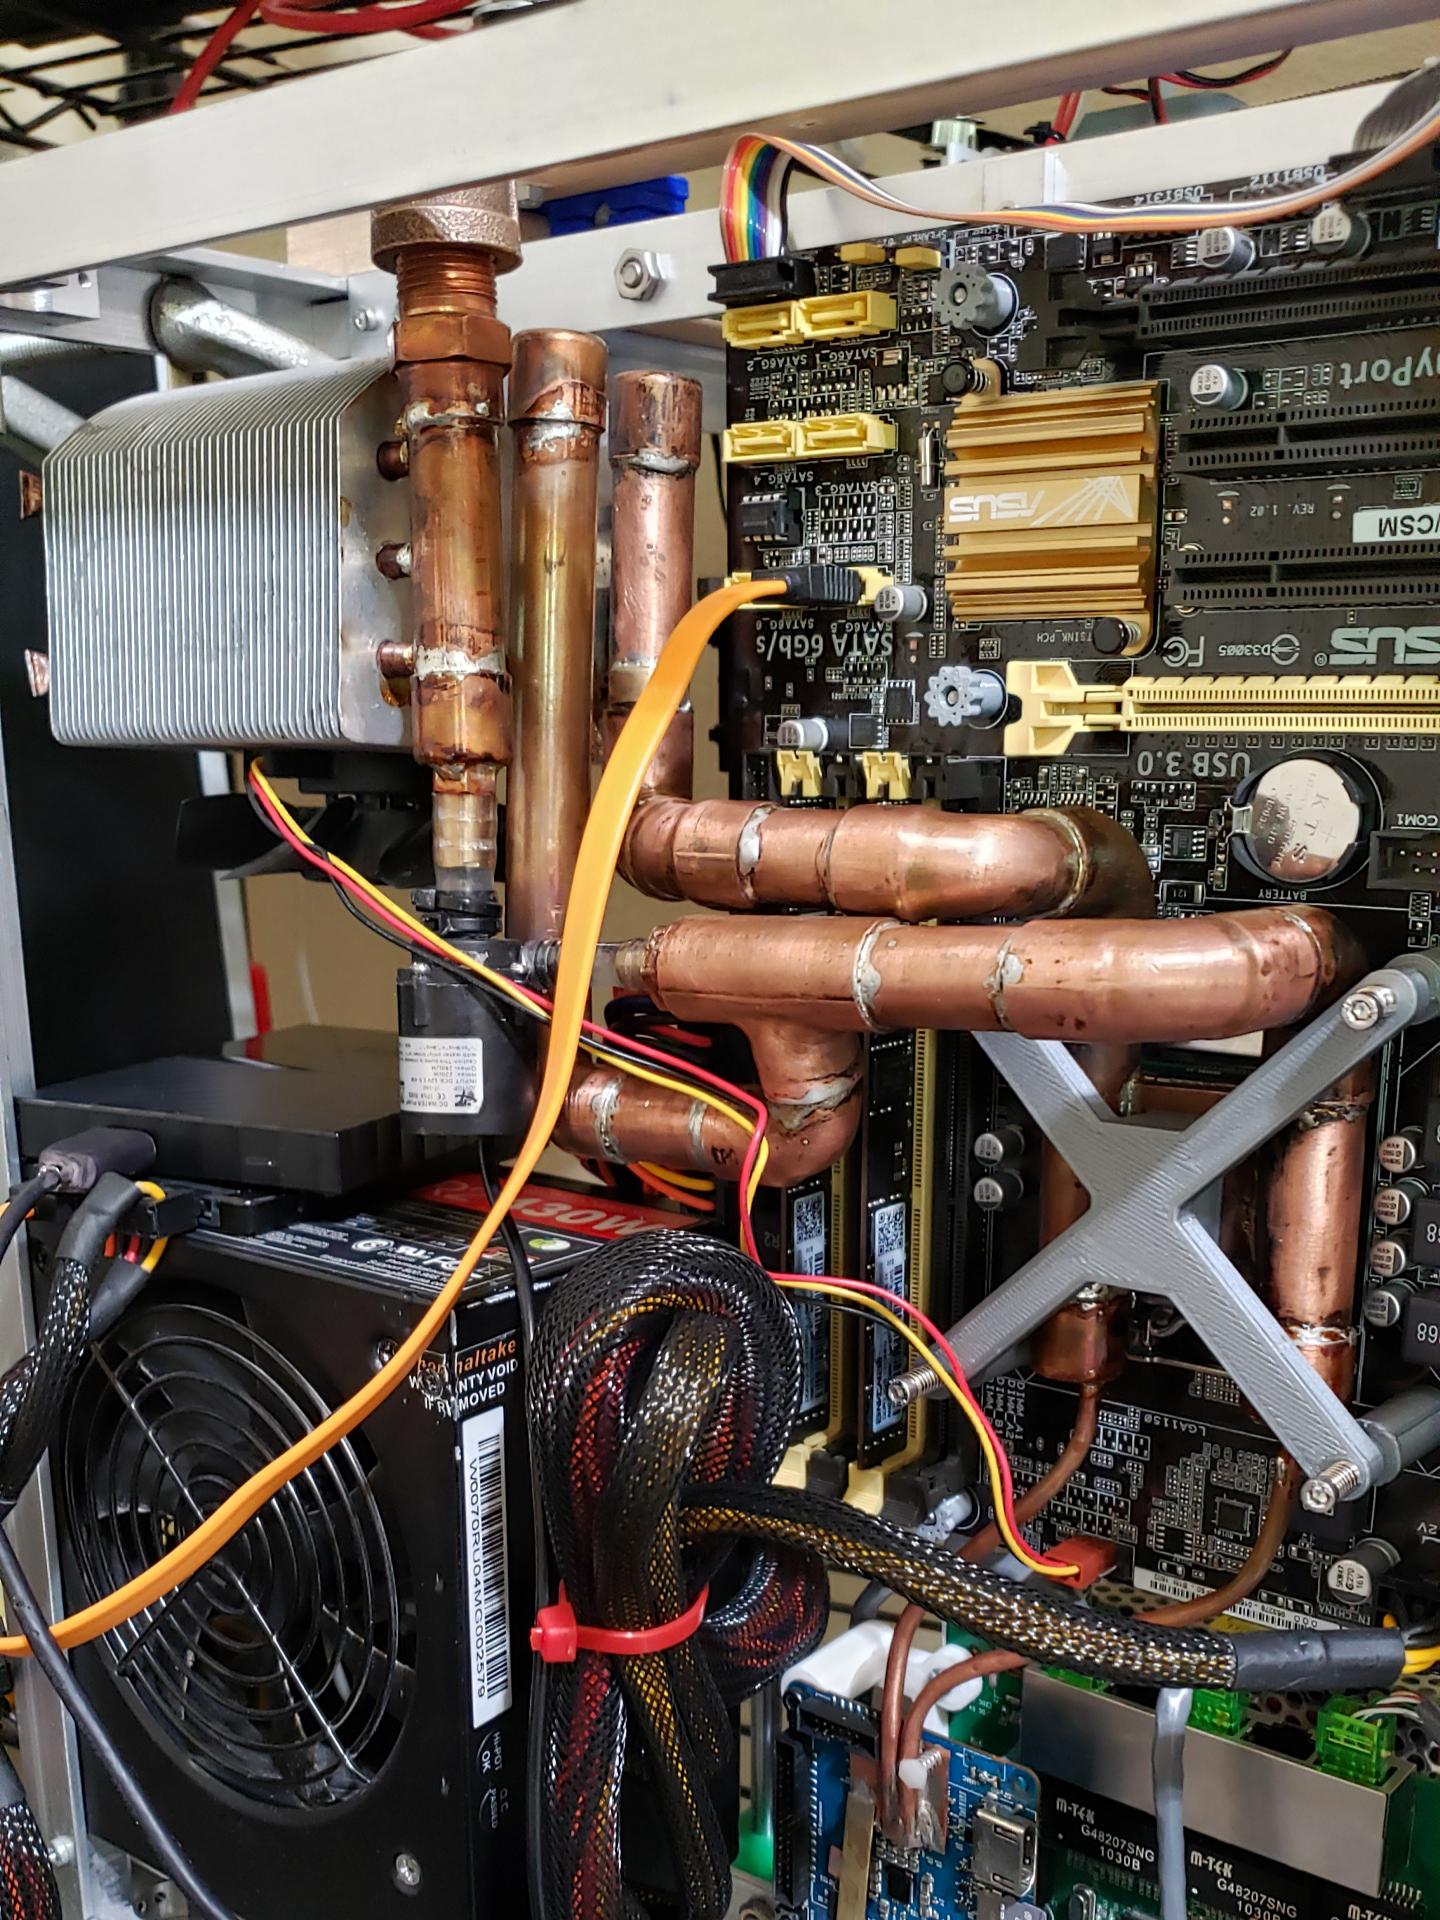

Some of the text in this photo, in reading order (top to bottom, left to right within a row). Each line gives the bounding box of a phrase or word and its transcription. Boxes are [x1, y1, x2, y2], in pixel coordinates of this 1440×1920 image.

[746, 353, 808, 372] SATA6G_2
[814, 346, 877, 362] SATA6G_1
[753, 471, 814, 486] SATA6G_4
[814, 481, 878, 496] SATA6G_3
[949, 490, 1045, 524] ASUS
[1249, 503, 1316, 517] REV. 1.02
[829, 619, 892, 634] SATA6G_5
[755, 630, 893, 662] SATA 6Gb/s
[1137, 751, 1251, 777] USB 3.0
[1395, 813, 1439, 826] COM1
[1257, 888, 1308, 902] BATTERY
[487, 1358, 519, 1382] VOID
[1004, 1379, 1016, 1441] DIMM_A2
[1014, 1380, 1026, 1440] DIMM_A1
[1143, 1413, 1207, 1437] LGA1150
[481, 1750, 492, 1774] OK
[1081, 1824, 1155, 1862] G48207SNG
[1099, 1845, 1141, 1871] 1030B
[1217, 1878, 1297, 1919] G48207SNG
